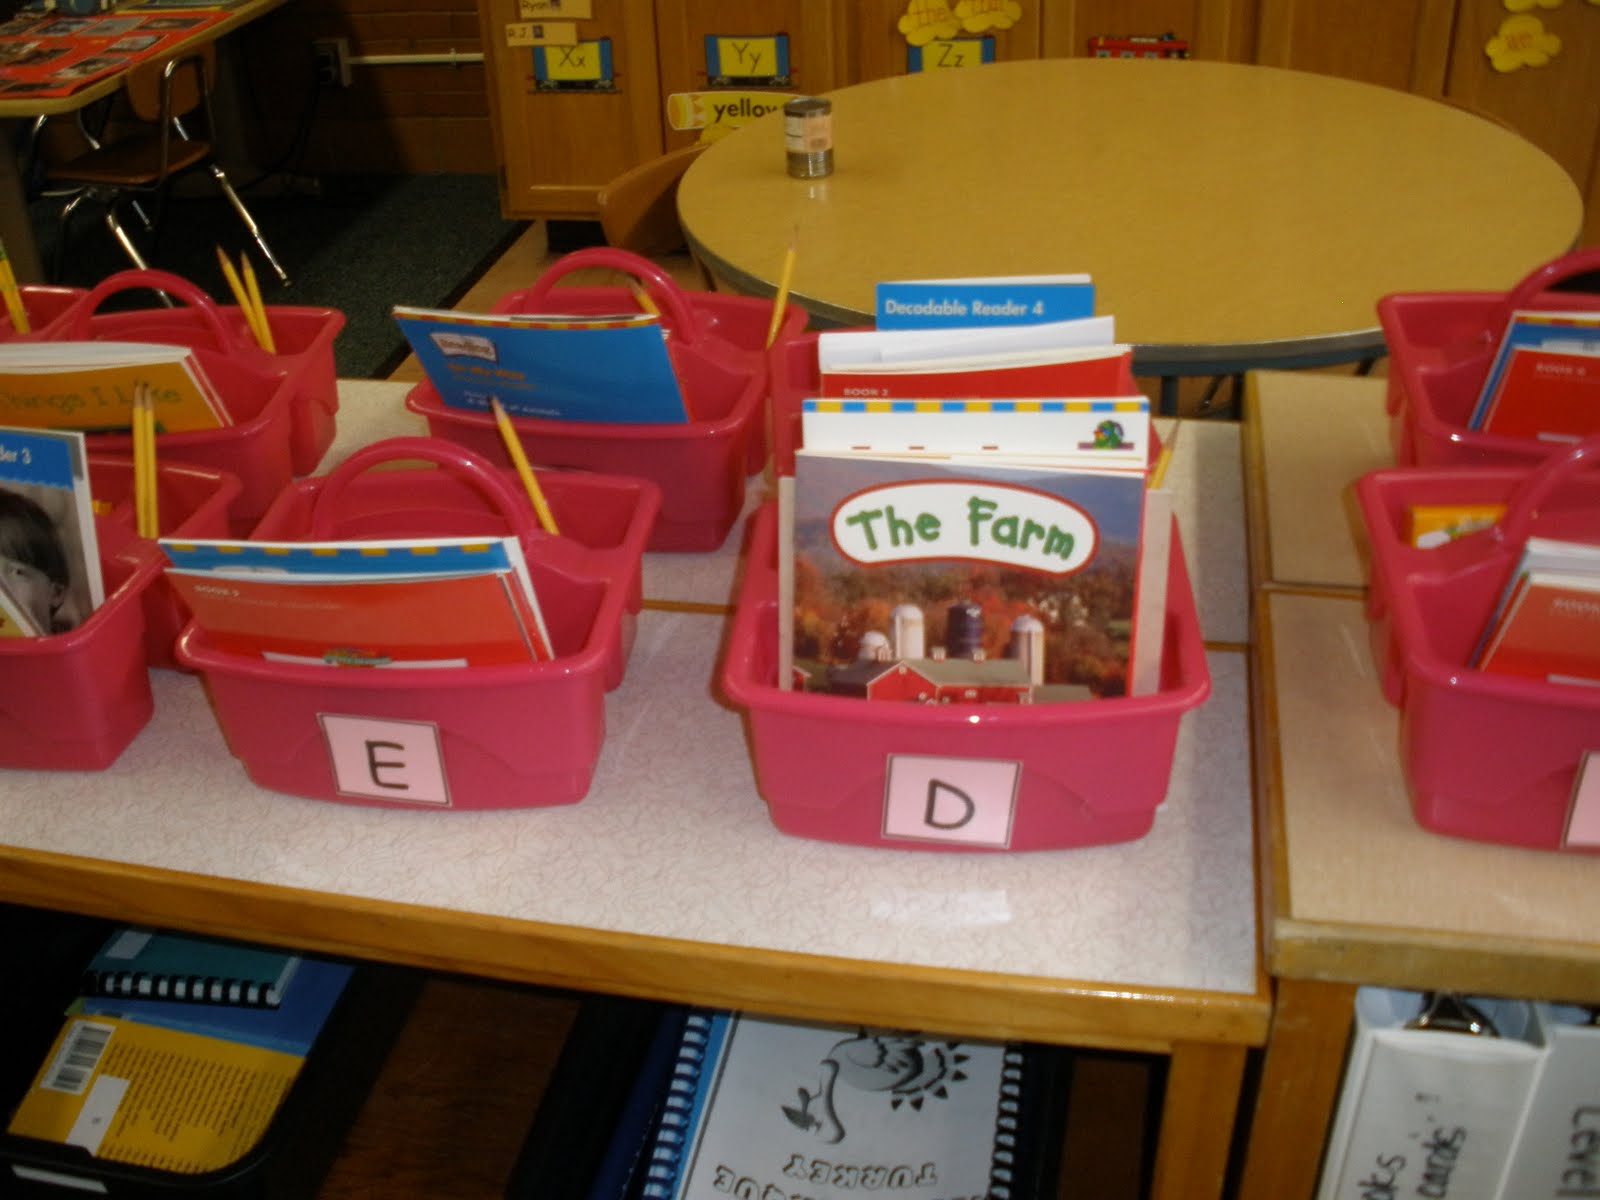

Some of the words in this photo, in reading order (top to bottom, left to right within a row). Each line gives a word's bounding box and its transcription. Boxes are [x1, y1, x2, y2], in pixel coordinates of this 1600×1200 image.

[731, 42, 762, 73] Yy
[936, 42, 965, 68] Zz
[884, 298, 967, 317] Decodable
[972, 299, 1027, 317] Reader
[1032, 300, 1044, 316] 4
[22, 447, 32, 466] 3
[846, 506, 941, 550] The
[967, 496, 1075, 561] Farm
[365, 740, 409, 790] E
[924, 778, 975, 831] D
[782, 1153, 937, 1190] TURKEY
